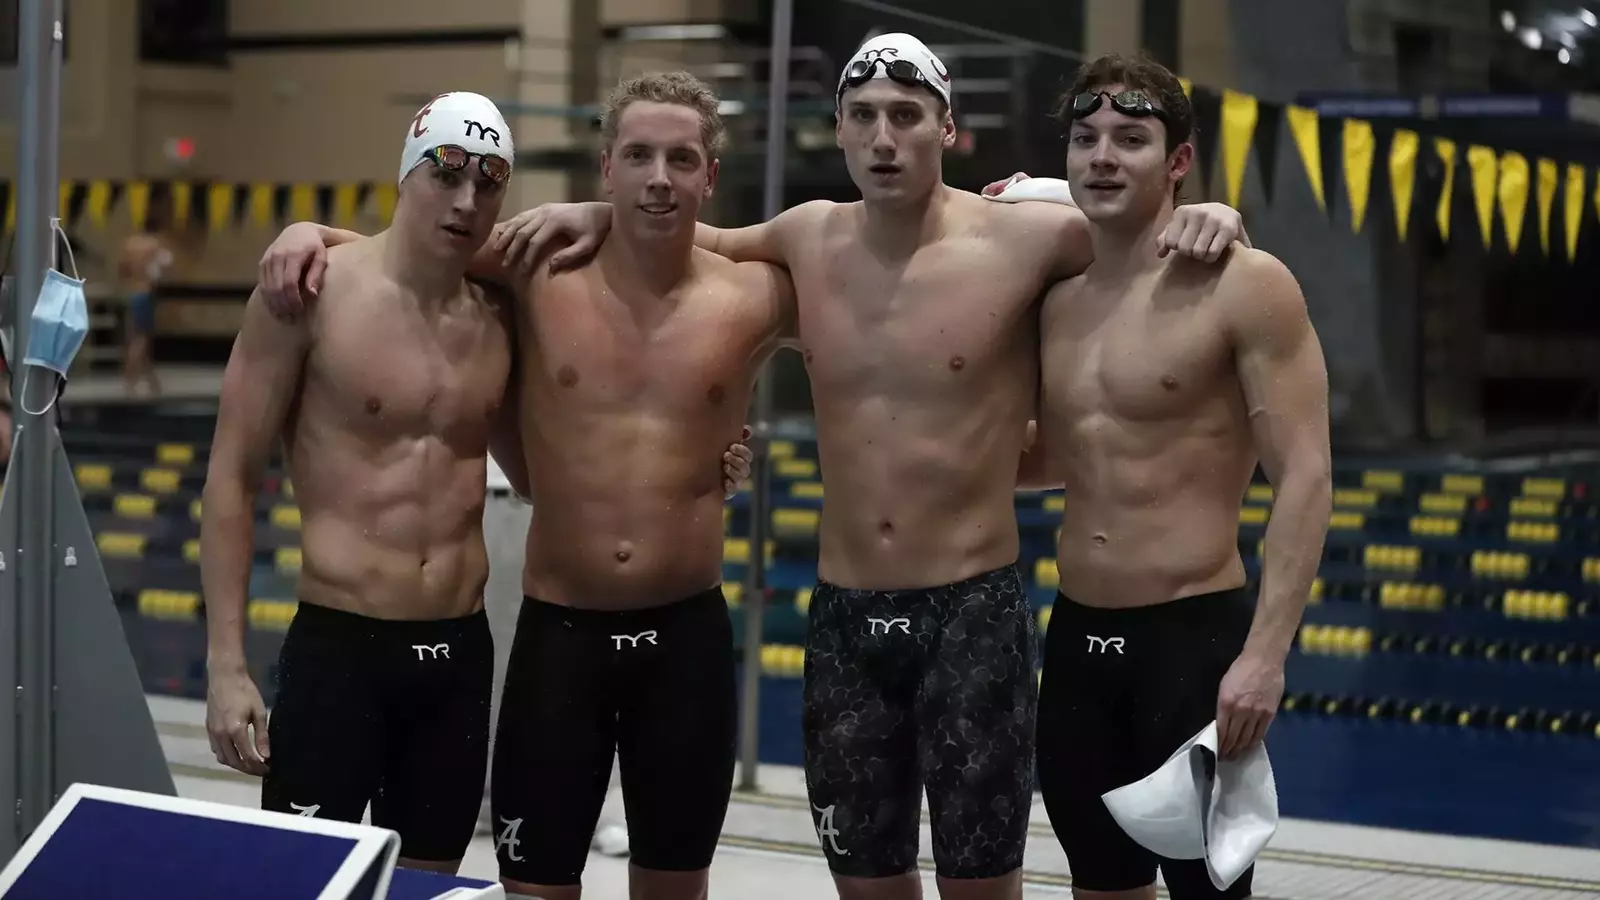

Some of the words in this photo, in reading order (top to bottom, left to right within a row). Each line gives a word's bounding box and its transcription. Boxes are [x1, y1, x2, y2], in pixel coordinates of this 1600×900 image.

[863, 47, 899, 60] TYR
[463, 119, 501, 148] TYR
[867, 617, 911, 635] TYR
[611, 630, 658, 650] TYR
[1086, 635, 1125, 654] TYR
[411, 643, 451, 661] TYR
